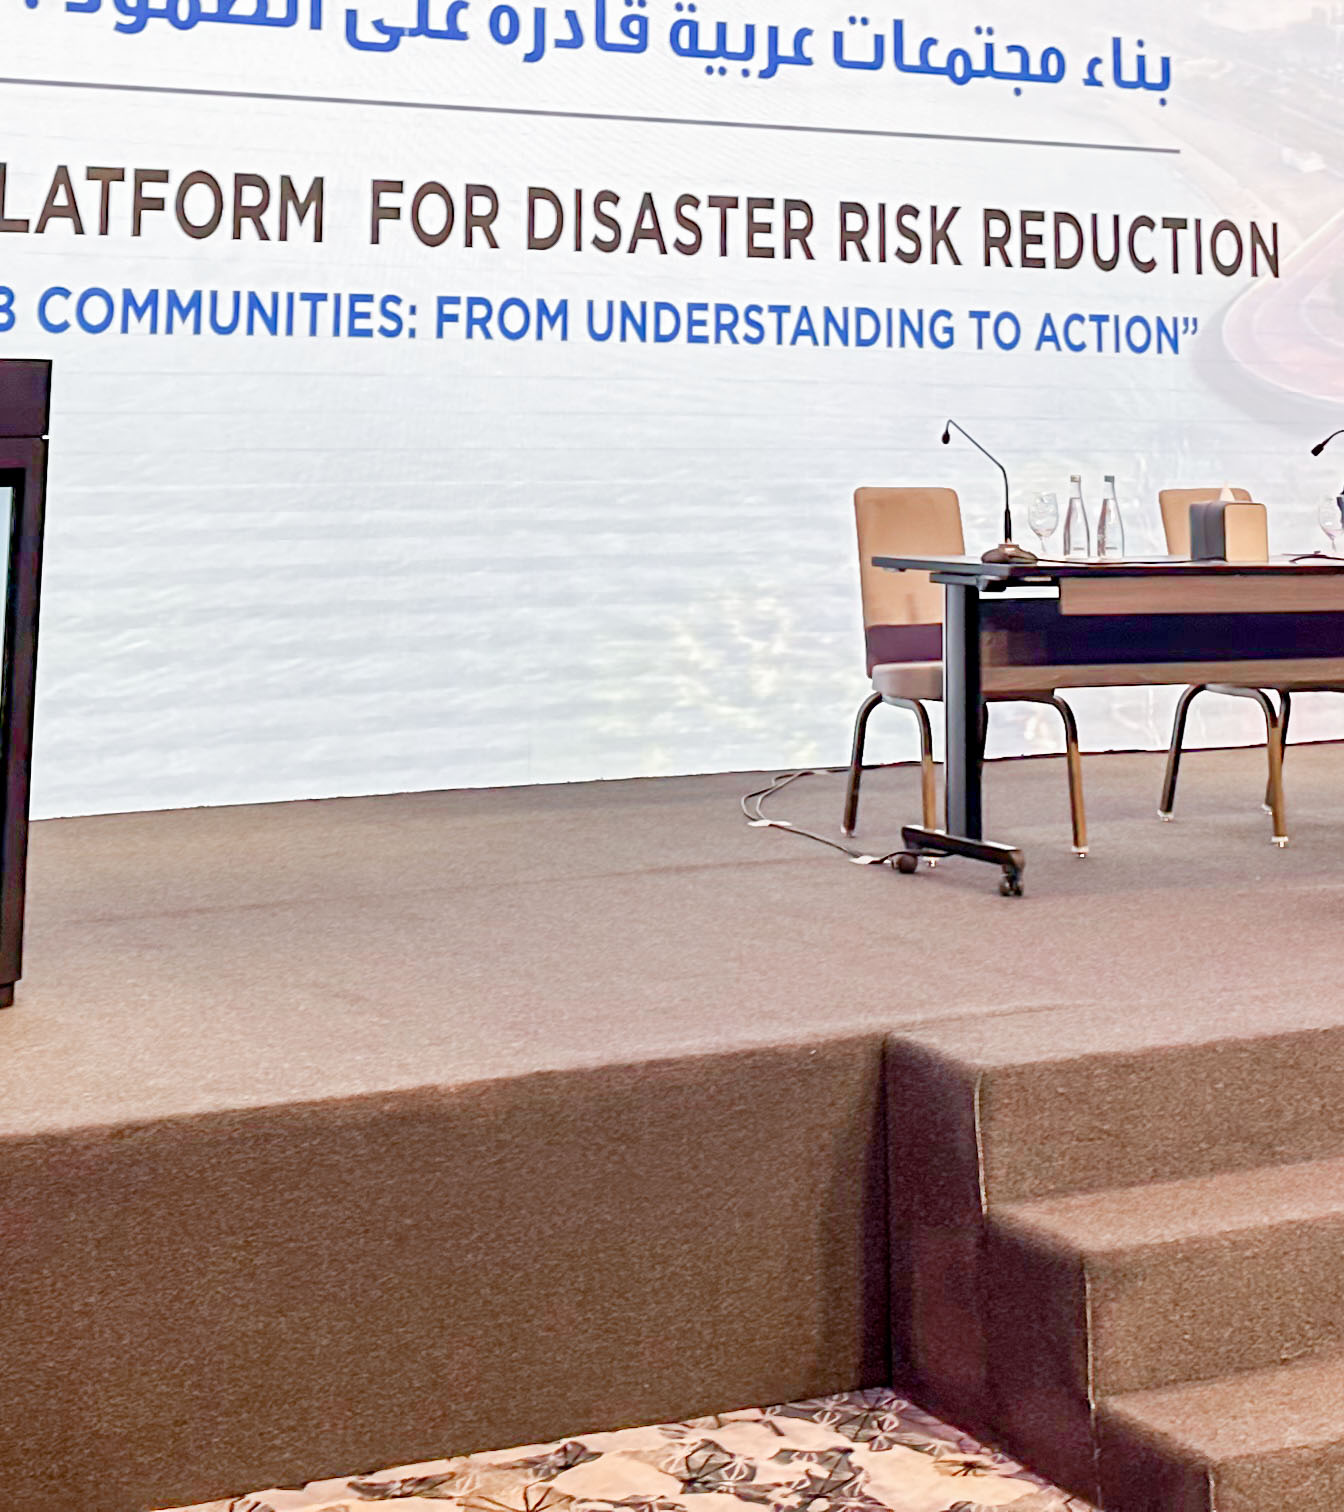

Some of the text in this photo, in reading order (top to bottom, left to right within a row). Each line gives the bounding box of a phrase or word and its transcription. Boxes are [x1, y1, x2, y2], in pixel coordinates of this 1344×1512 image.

[669, 2, 814, 80] عربية
[832, 16, 1066, 97] مجتمعات
[1082, 37, 1171, 107] بناء
[370, 179, 500, 249] FOR
[526, 186, 816, 260] DISASTER
[839, 201, 963, 266] RISK
[983, 208, 1279, 278] REDUCTION
[37, 286, 417, 339] COMMUNITIES:
[436, 296, 568, 341] FROM
[587, 299, 954, 350] UNDERSTANDING
[968, 310, 1021, 351] TO
